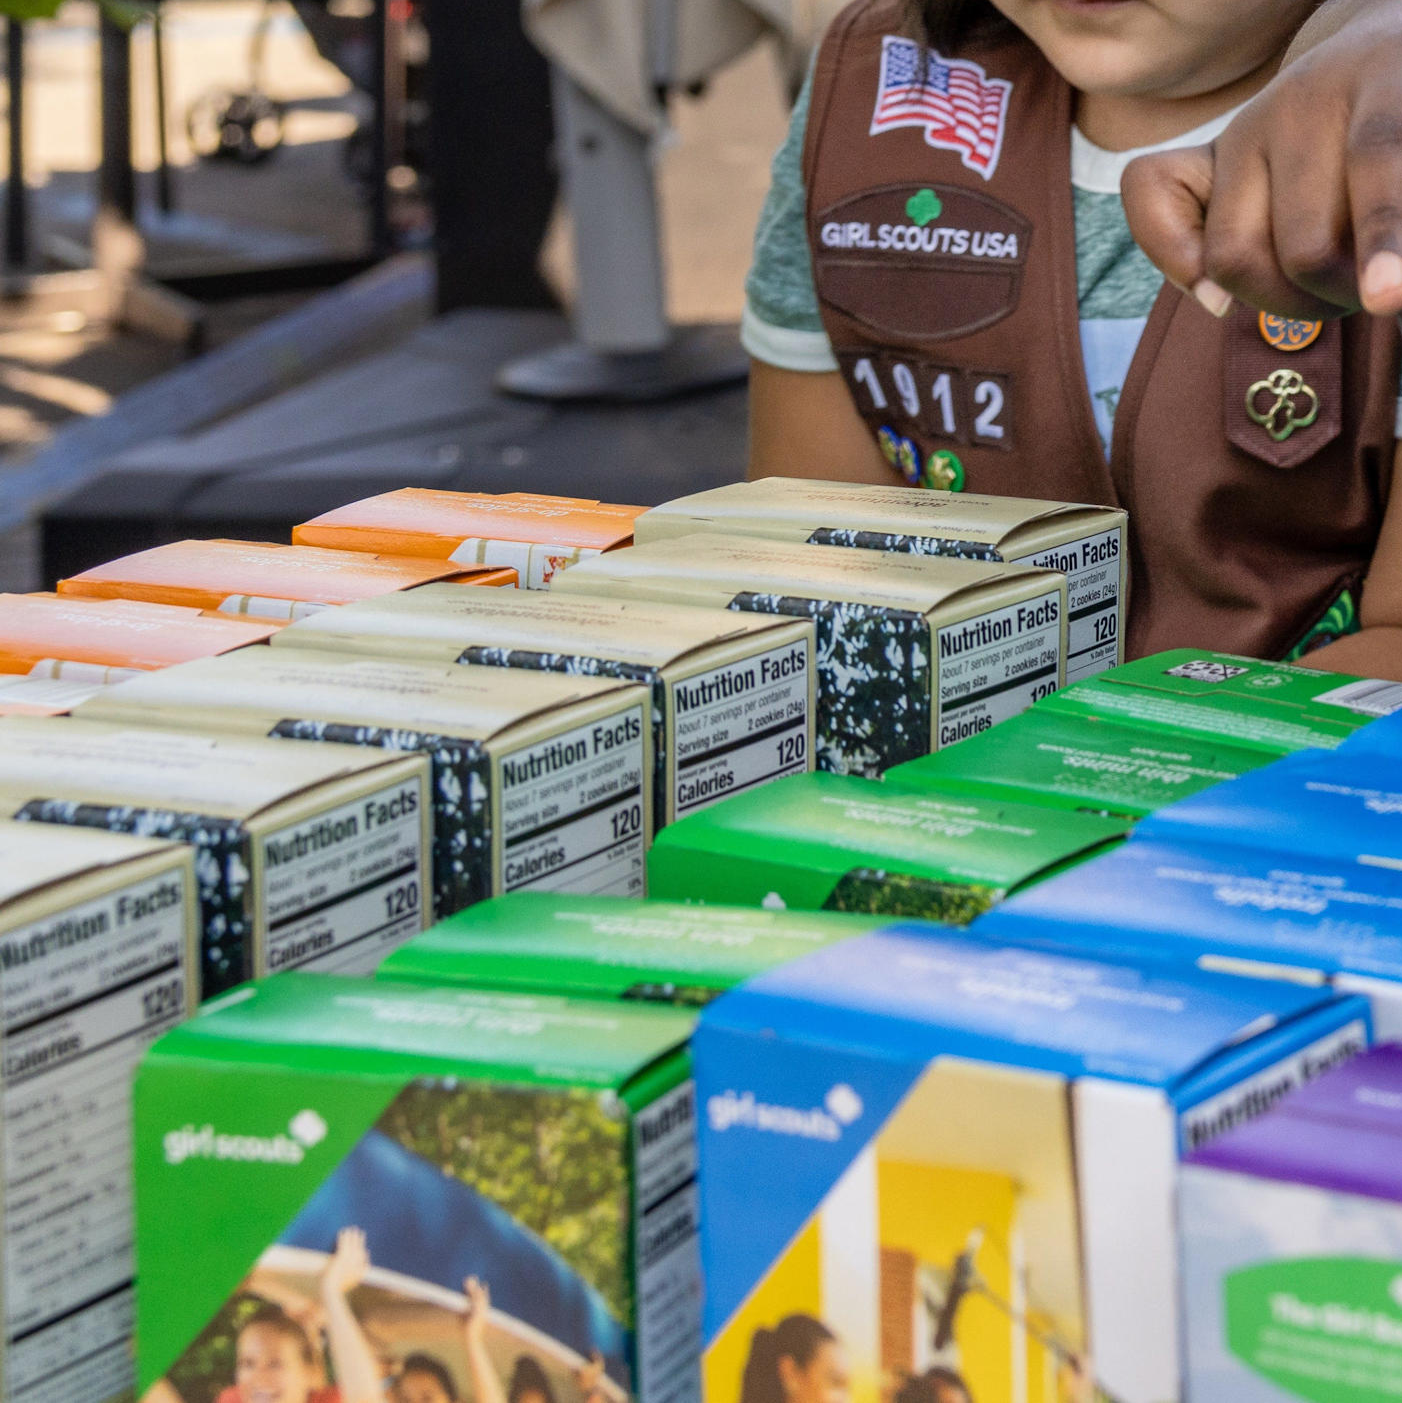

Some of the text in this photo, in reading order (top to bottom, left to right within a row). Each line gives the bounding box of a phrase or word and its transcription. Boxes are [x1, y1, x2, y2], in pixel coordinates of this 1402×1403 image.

[821, 221, 1018, 259] GIRL SCOUTS USA
[854, 358, 1005, 438] 1912
[1082, 536, 1118, 567] Facts
[1080, 570, 1107, 588] container
[1071, 598, 1076, 608] 2
[1076, 590, 1101, 607] cookies
[941, 600, 1058, 658] Nutrition Facts
[1094, 613, 1117, 642] 120
[941, 636, 1046, 679] About 7 servings per container
[941, 648, 1058, 699] Serving size 2 cookies (24g)
[676, 650, 805, 713] Nutrition Facts
[710, 704, 743, 728] servings
[744, 700, 757, 716] per
[758, 685, 793, 711] container
[677, 736, 711, 757] Serving
[712, 728, 729, 744] size
[748, 718, 753, 731] 2
[754, 708, 785, 730] cookies
[941, 714, 993, 746] Calories
[503, 716, 641, 790] Nutrition Facts
[777, 733, 805, 766] 120
[678, 770, 735, 805] Calories
[266, 815, 358, 868] Nutrition
[364, 789, 418, 831] Facts
[611, 804, 641, 839] 120
[505, 847, 566, 884] Calories
[385, 881, 418, 919] 120
[164, 1121, 305, 1166] girl scouts
